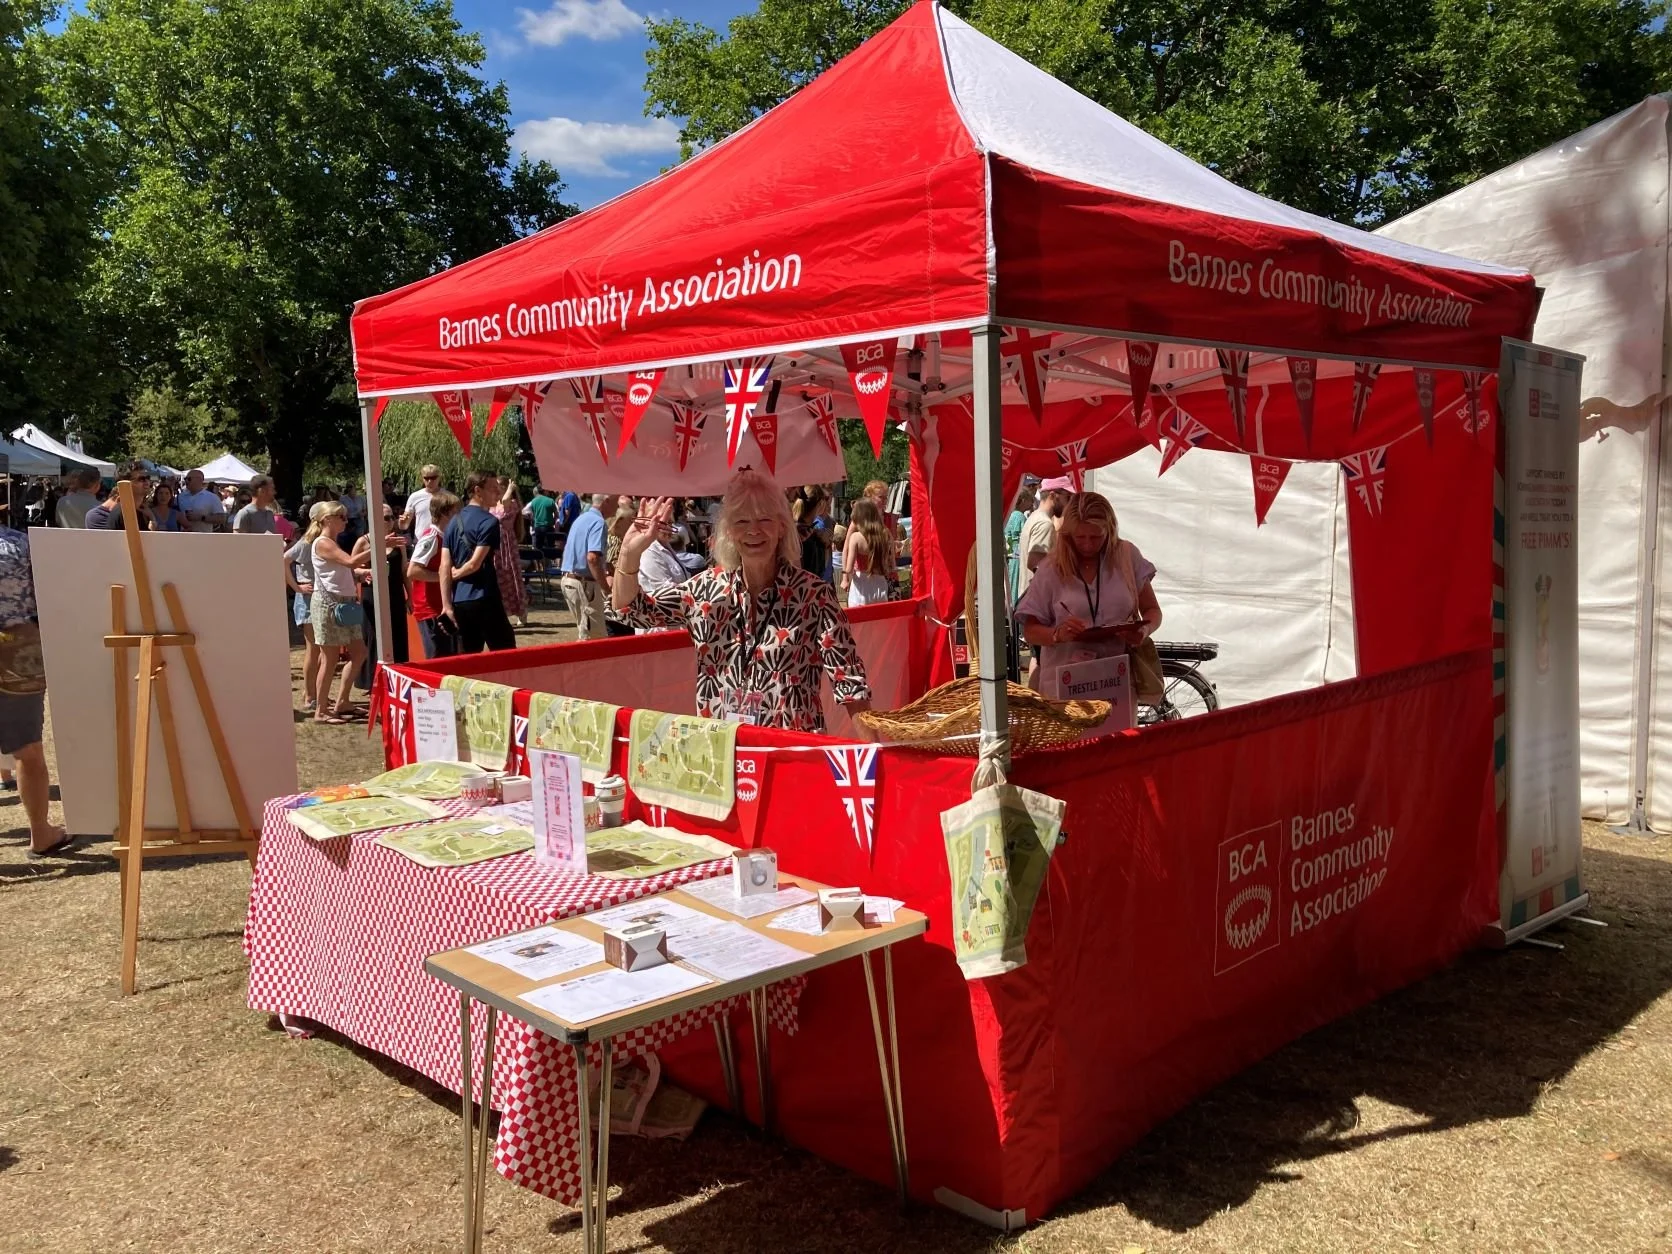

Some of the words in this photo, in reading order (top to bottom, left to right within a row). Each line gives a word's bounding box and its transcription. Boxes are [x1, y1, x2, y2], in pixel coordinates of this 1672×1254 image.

[439, 317, 502, 350] Barnes
[506, 283, 635, 332] Community
[637, 249, 802, 317] Association
[1169, 239, 1253, 295] Barnes
[1259, 258, 1376, 327] Community
[1378, 283, 1473, 328] Association
[1067, 682, 1097, 695] TRESTLE
[1101, 676, 1122, 688] TABLE
[1291, 803, 1355, 851] Barnes
[1291, 825, 1394, 893] Community
[1229, 840, 1268, 883] BCA
[1291, 867, 1388, 937] Association
